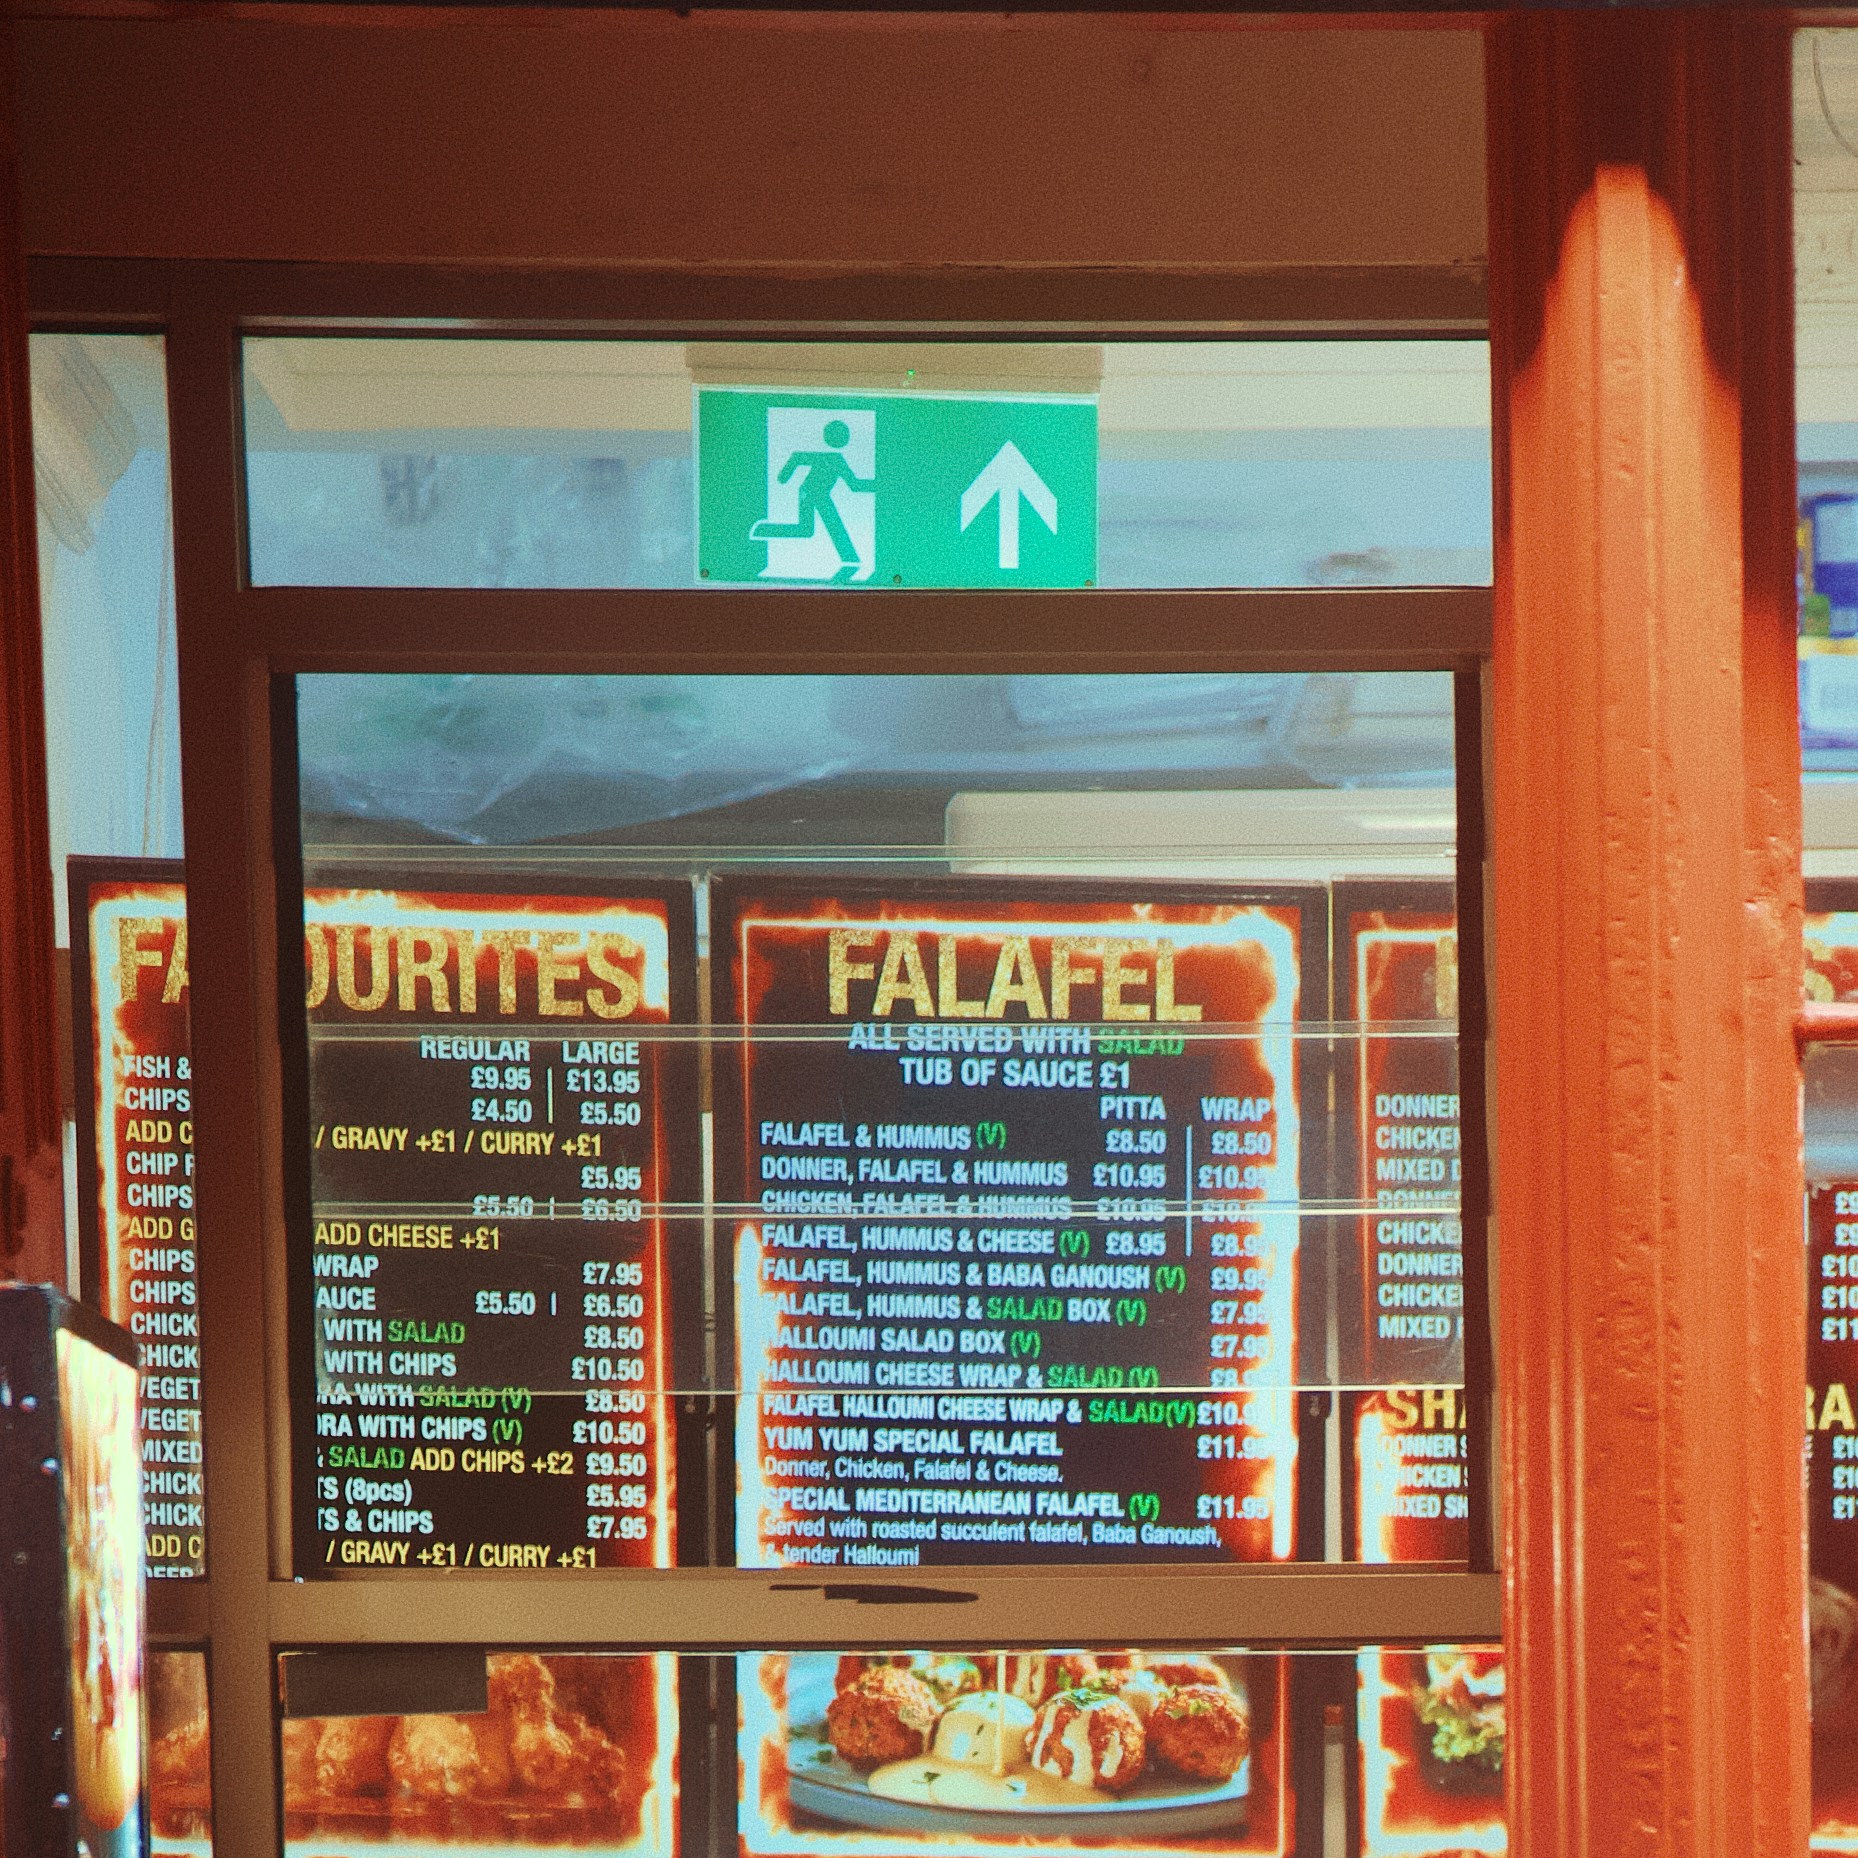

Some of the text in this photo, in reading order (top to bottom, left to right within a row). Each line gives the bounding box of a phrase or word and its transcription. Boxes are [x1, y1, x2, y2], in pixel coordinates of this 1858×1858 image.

[829, 930, 1202, 1021] FALAFEL
[421, 1037, 640, 1065] REGULAR LARGE
[125, 1056, 171, 1079] FISH
[471, 1068, 531, 1092] £9.95
[567, 1070, 640, 1093] £13.95
[899, 1057, 1129, 1088] TUB OF SAUCE £1
[125, 1088, 640, 1126] CHIPS £4.50 £5.50
[1101, 1097, 1271, 1121] PITTA WRAP
[126, 1121, 172, 1144] ADD
[332, 1127, 408, 1151] GRAVY
[415, 1131, 456, 1154] +£1
[481, 1132, 554, 1156] CURRY
[561, 1135, 601, 1157] +£1
[761, 1122, 1006, 1150] FALAFEL & HUMMUS (V)
[127, 1152, 178, 1176] CHIP
[1377, 1158, 1445, 1181] MIXED
[315, 1223, 500, 1250] ADD CHEESE +£1
[762, 1226, 1166, 1258] FALAFEL, HUMMUS & CHEESE (V) £8.95
[315, 1255, 642, 1285] WRAP £7.95
[325, 1319, 644, 1350] WITH SALAD £8.50
[359, 1415, 645, 1445] WITH CHIPS (V) £10.50
[765, 1427, 1062, 1455] YUM YUM SPECIAL FALAFEL
[329, 1446, 646, 1476] SALAD ADD CHIPS +£2 £9.50
[765, 1458, 1063, 1482] Donner, Chicken, Falafel & Cheese.
[344, 1478, 646, 1508] (8pcs) £5.95
[855, 1490, 1159, 1520] MEDITERRANEAN FALAFEL (V)
[830, 1519, 1221, 1548] with roasted succulent falafel, Baba Ganoush,
